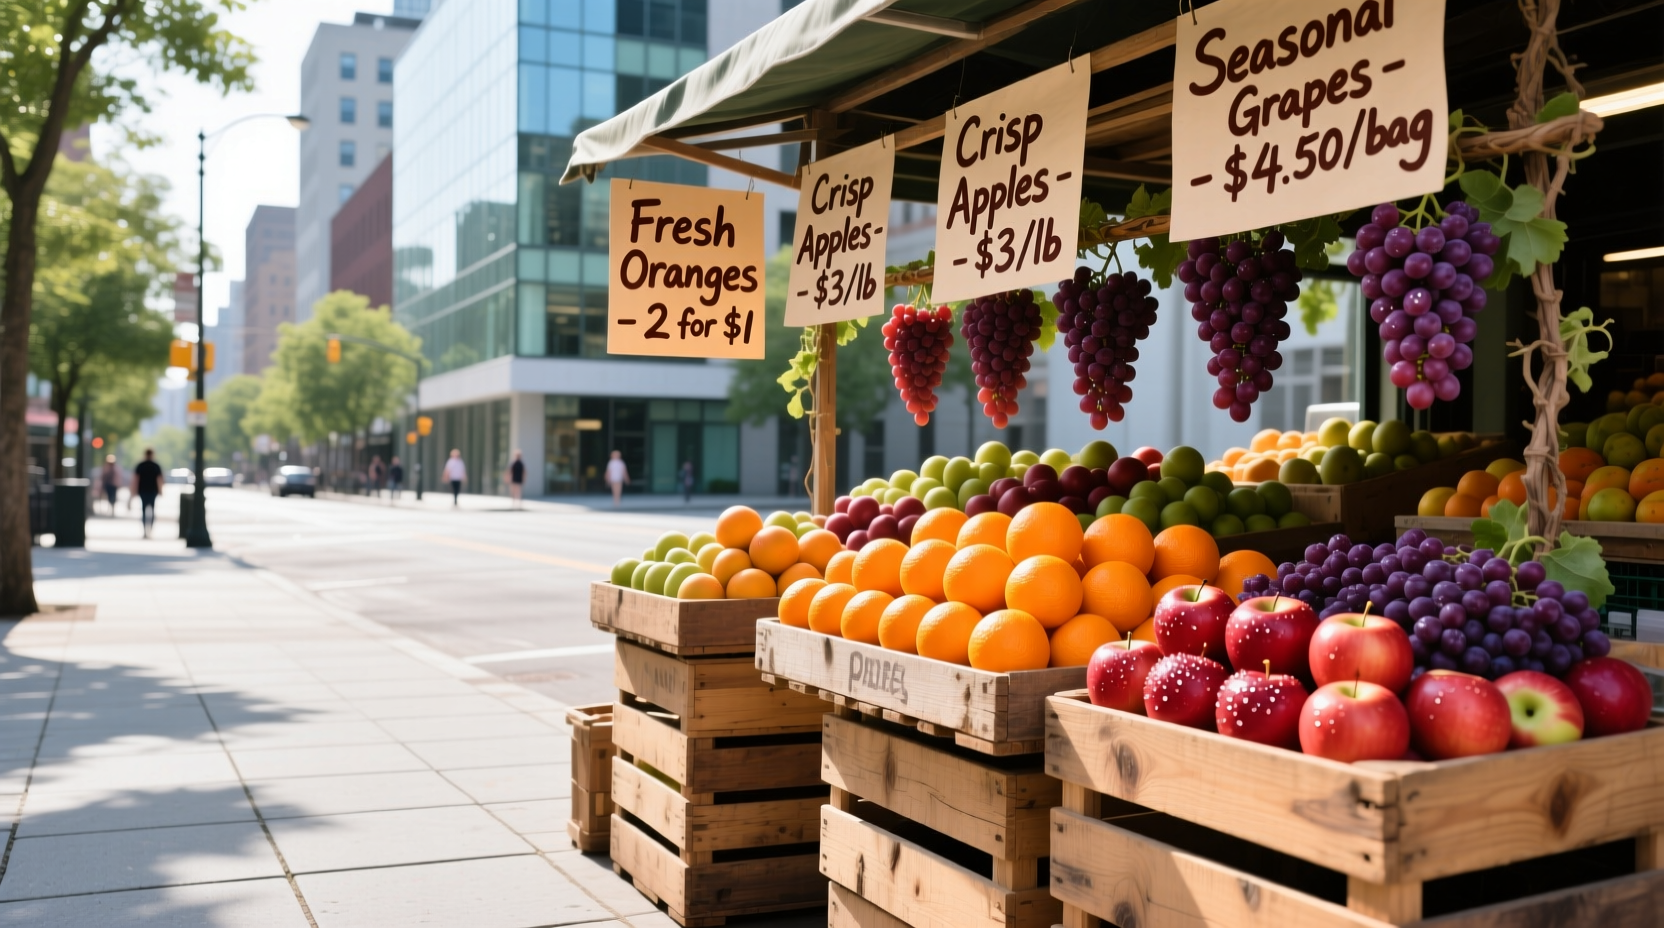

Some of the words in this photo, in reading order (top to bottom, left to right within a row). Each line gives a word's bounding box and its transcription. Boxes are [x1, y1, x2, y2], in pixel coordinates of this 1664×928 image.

[1189, 0, 1394, 96] Seasonal
[1228, 59, 1372, 137] Grapes
[956, 113, 1043, 167] Crisp
[1223, 107, 1433, 202] $4.50/bag
[630, 198, 735, 248] Fresh
[811, 173, 874, 218] Crisp
[975, 217, 1062, 278] $3/lb
[620, 249, 758, 306] Oranges
[814, 262, 877, 309] $3/lb
[644, 303, 670, 339] 2
[677, 307, 717, 339] for
[723, 306, 754, 345] $1
